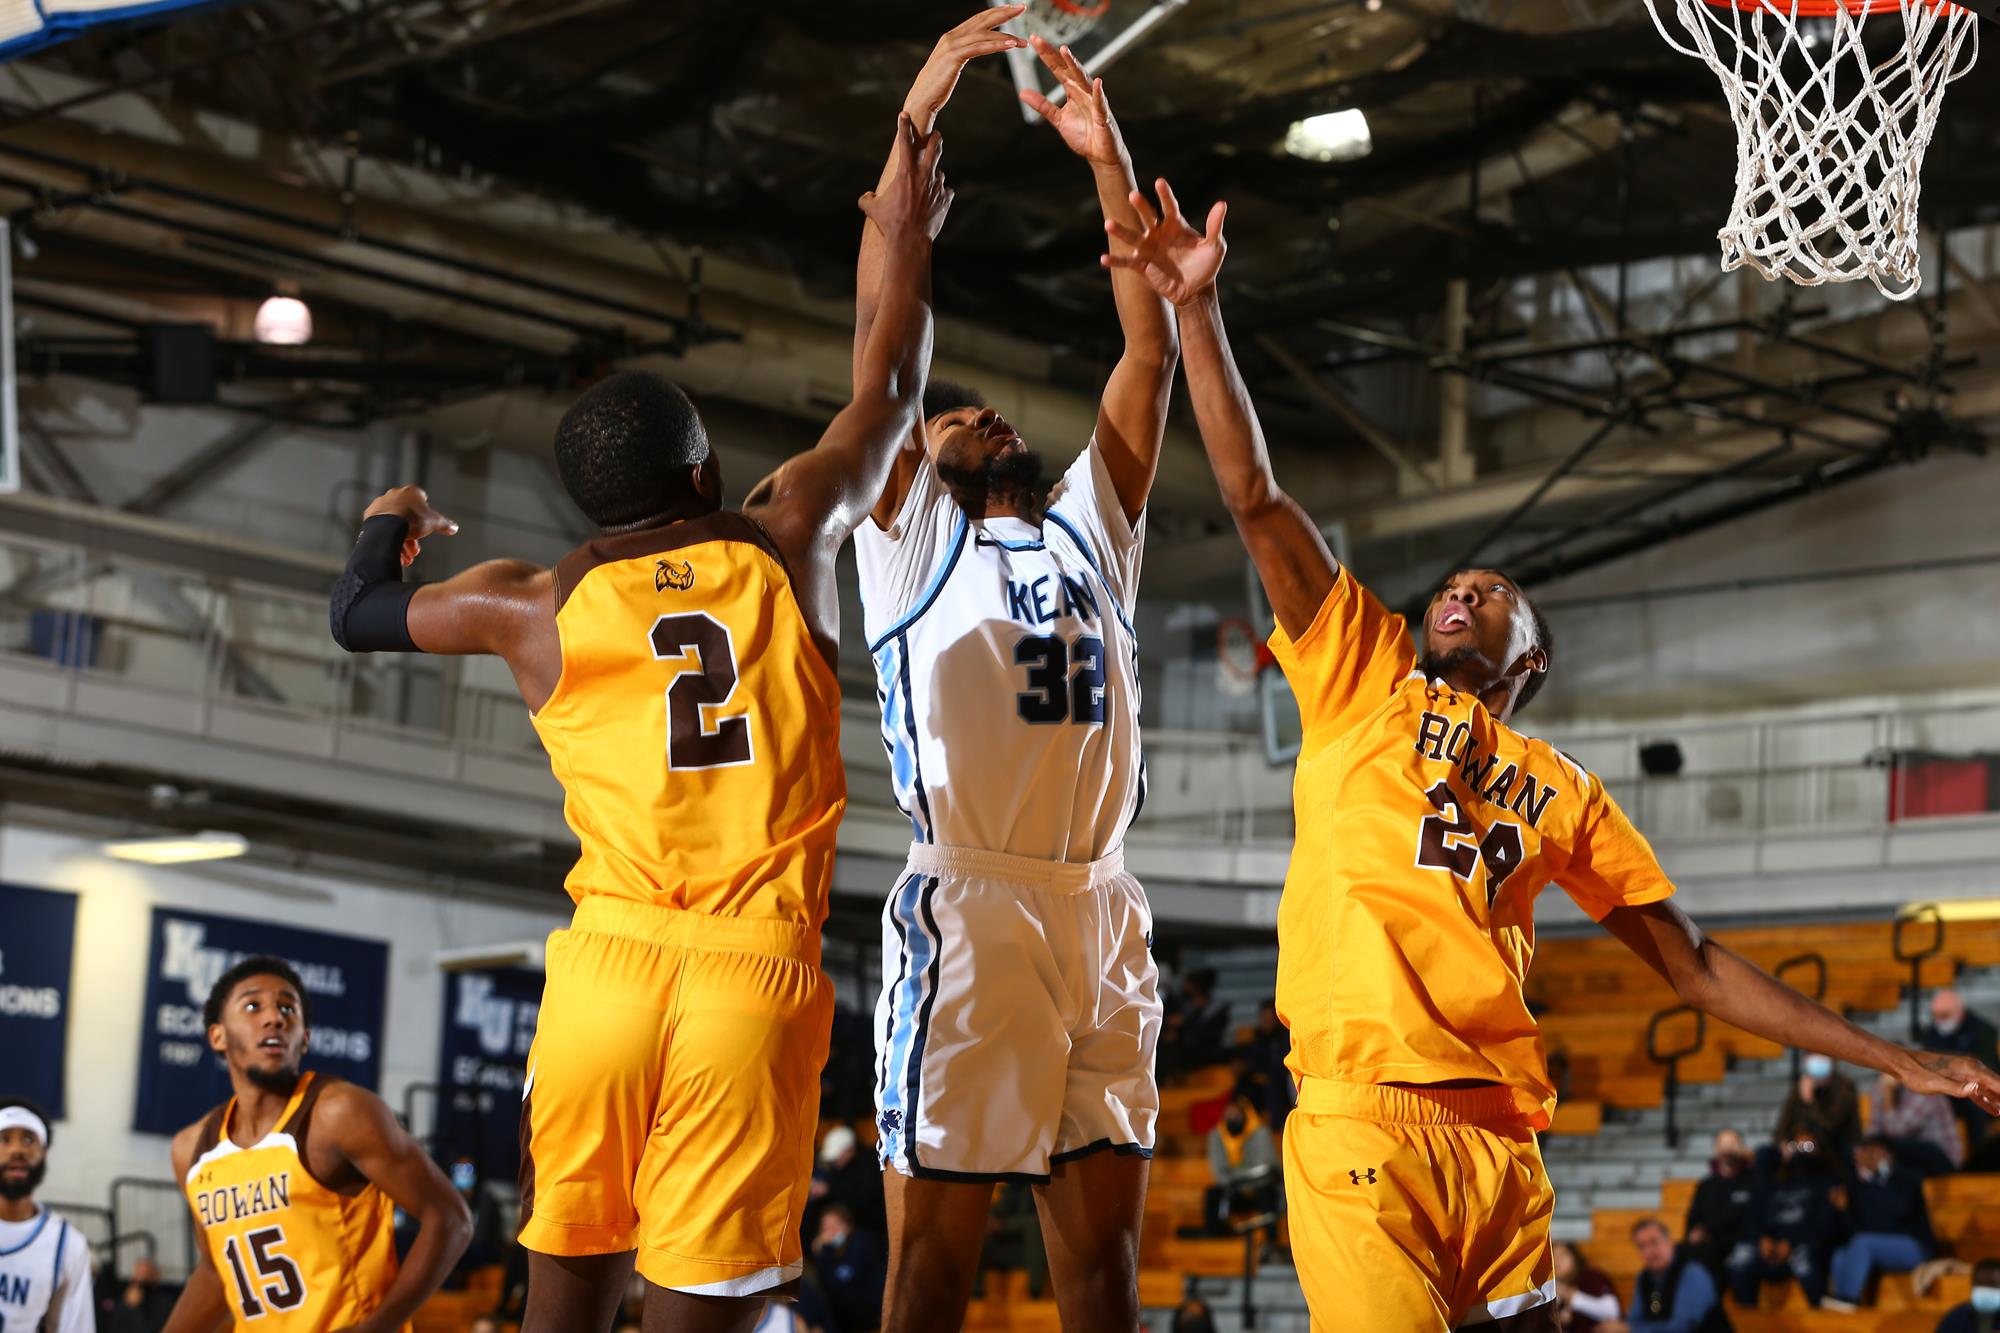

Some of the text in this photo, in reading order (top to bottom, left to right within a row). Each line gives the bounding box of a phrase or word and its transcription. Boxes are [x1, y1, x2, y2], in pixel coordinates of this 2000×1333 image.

[1006, 572, 1101, 626] KEAN
[648, 610, 755, 771] 2
[1014, 633, 1106, 725] 32
[1414, 711, 1559, 829] ROWAN
[1414, 778, 1526, 911] 24
[198, 1173, 291, 1227] ROWAN
[225, 1224, 307, 1321] 15
